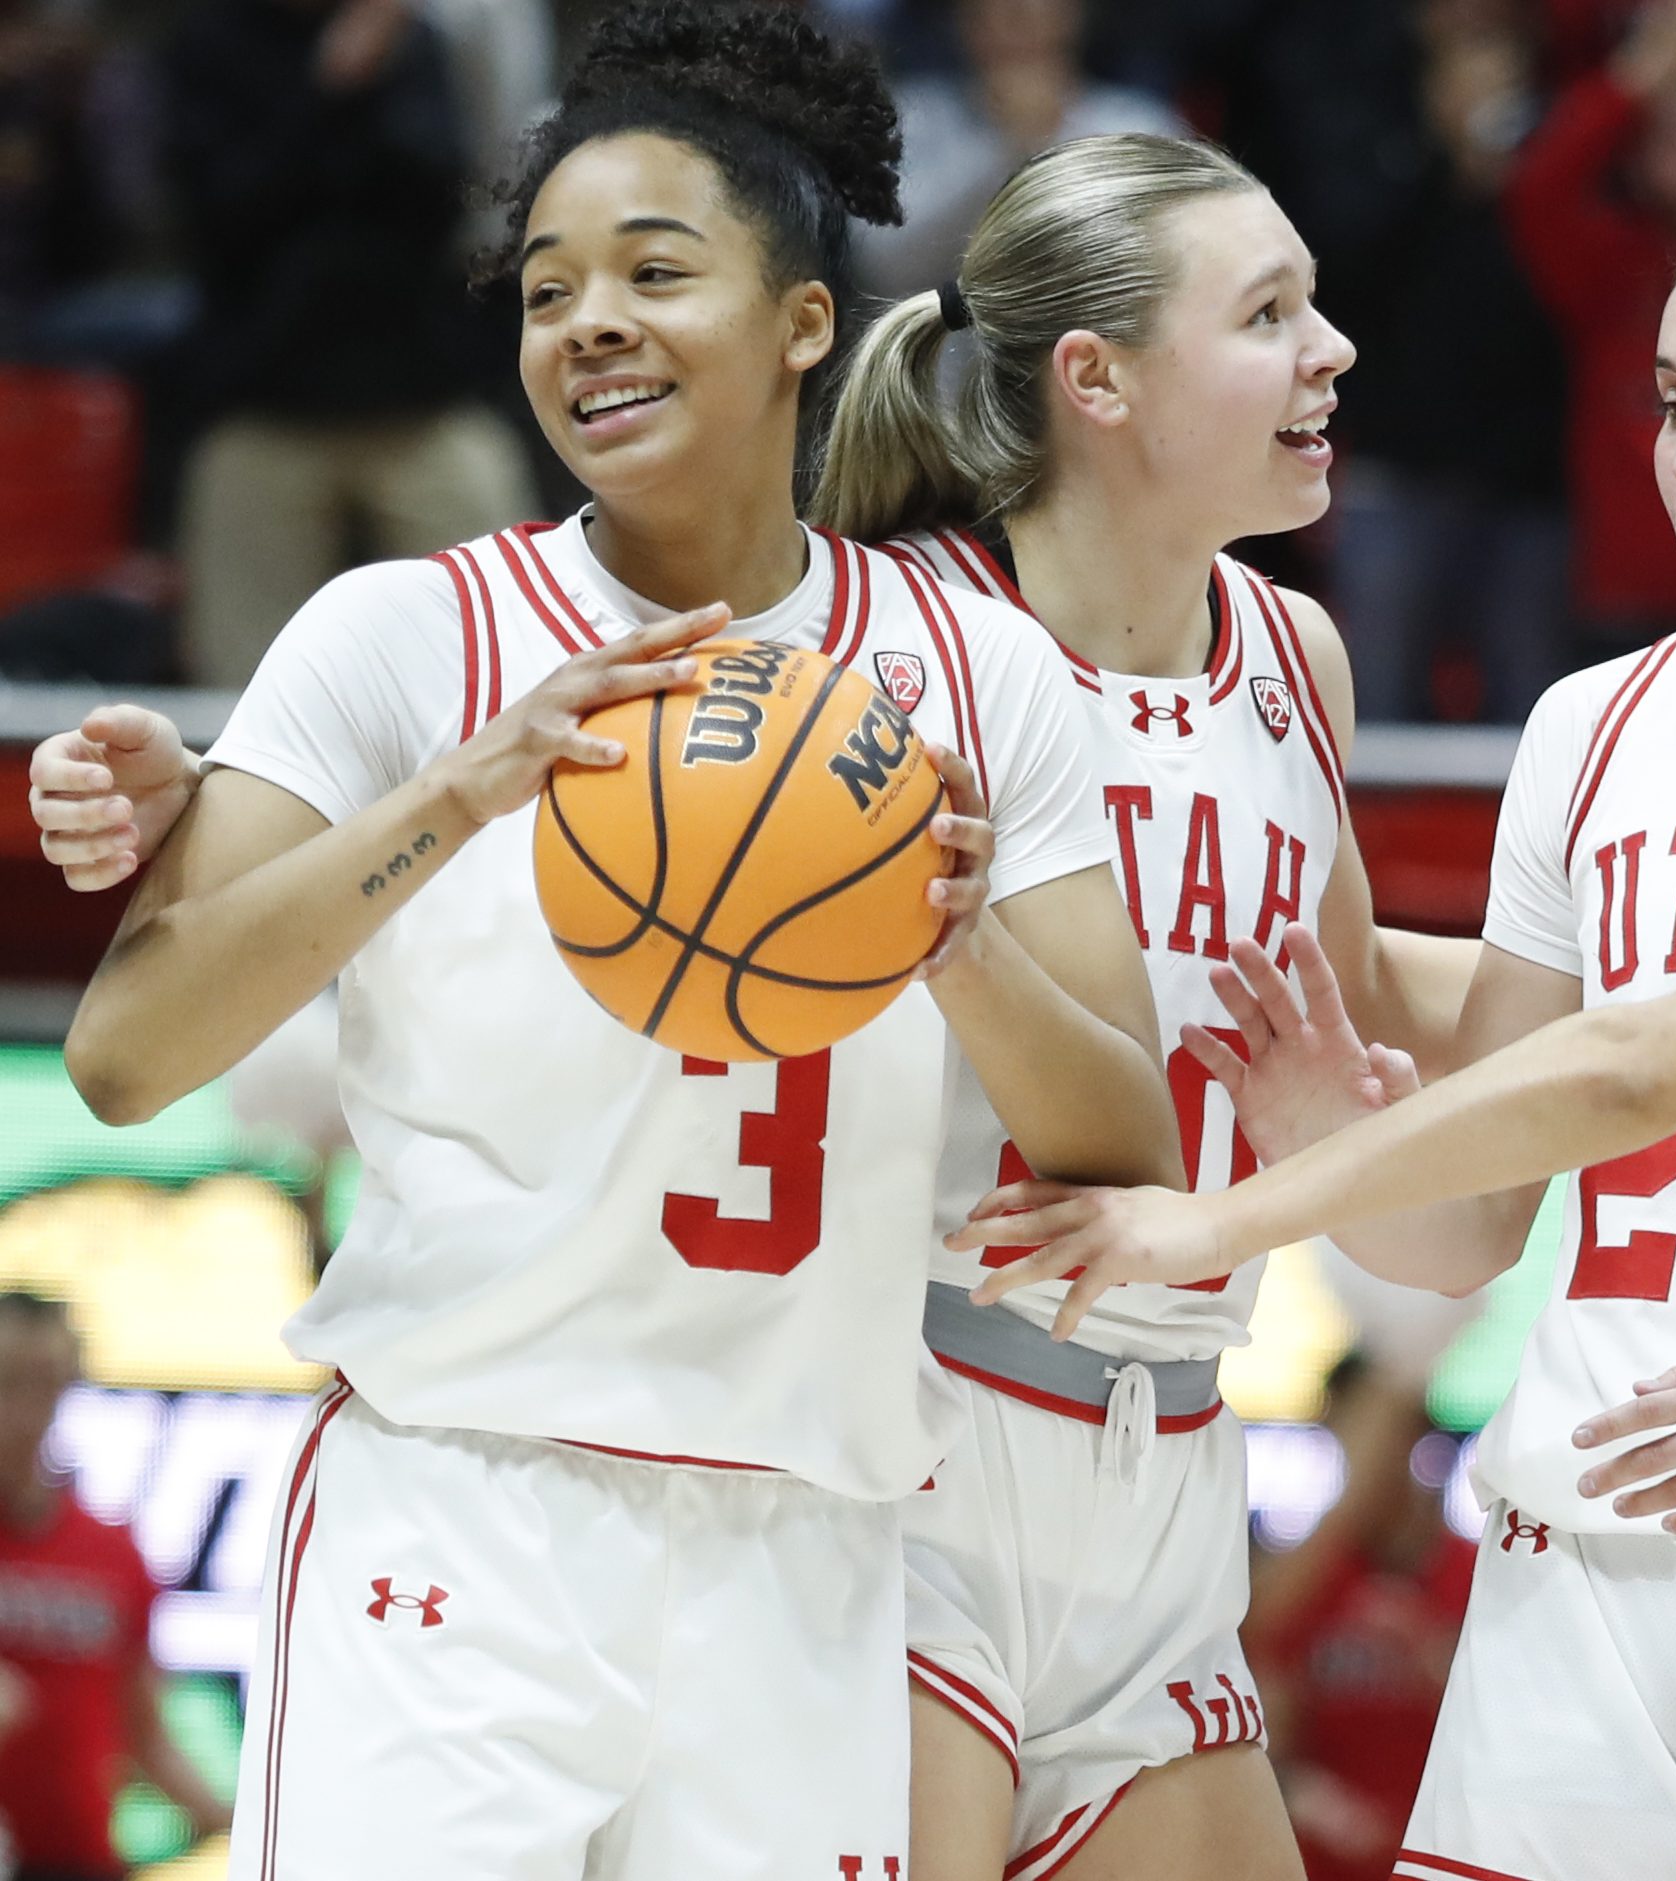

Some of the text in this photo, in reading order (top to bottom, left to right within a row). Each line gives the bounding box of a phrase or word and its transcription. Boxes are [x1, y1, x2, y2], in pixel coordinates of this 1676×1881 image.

[876, 653, 924, 691] PAC
[891, 677, 917, 702] 12
[1251, 680, 1290, 717] PAC
[1266, 703, 1287, 728] 12
[1103, 784, 1306, 978] TAH
[661, 1045, 832, 1277] 3
